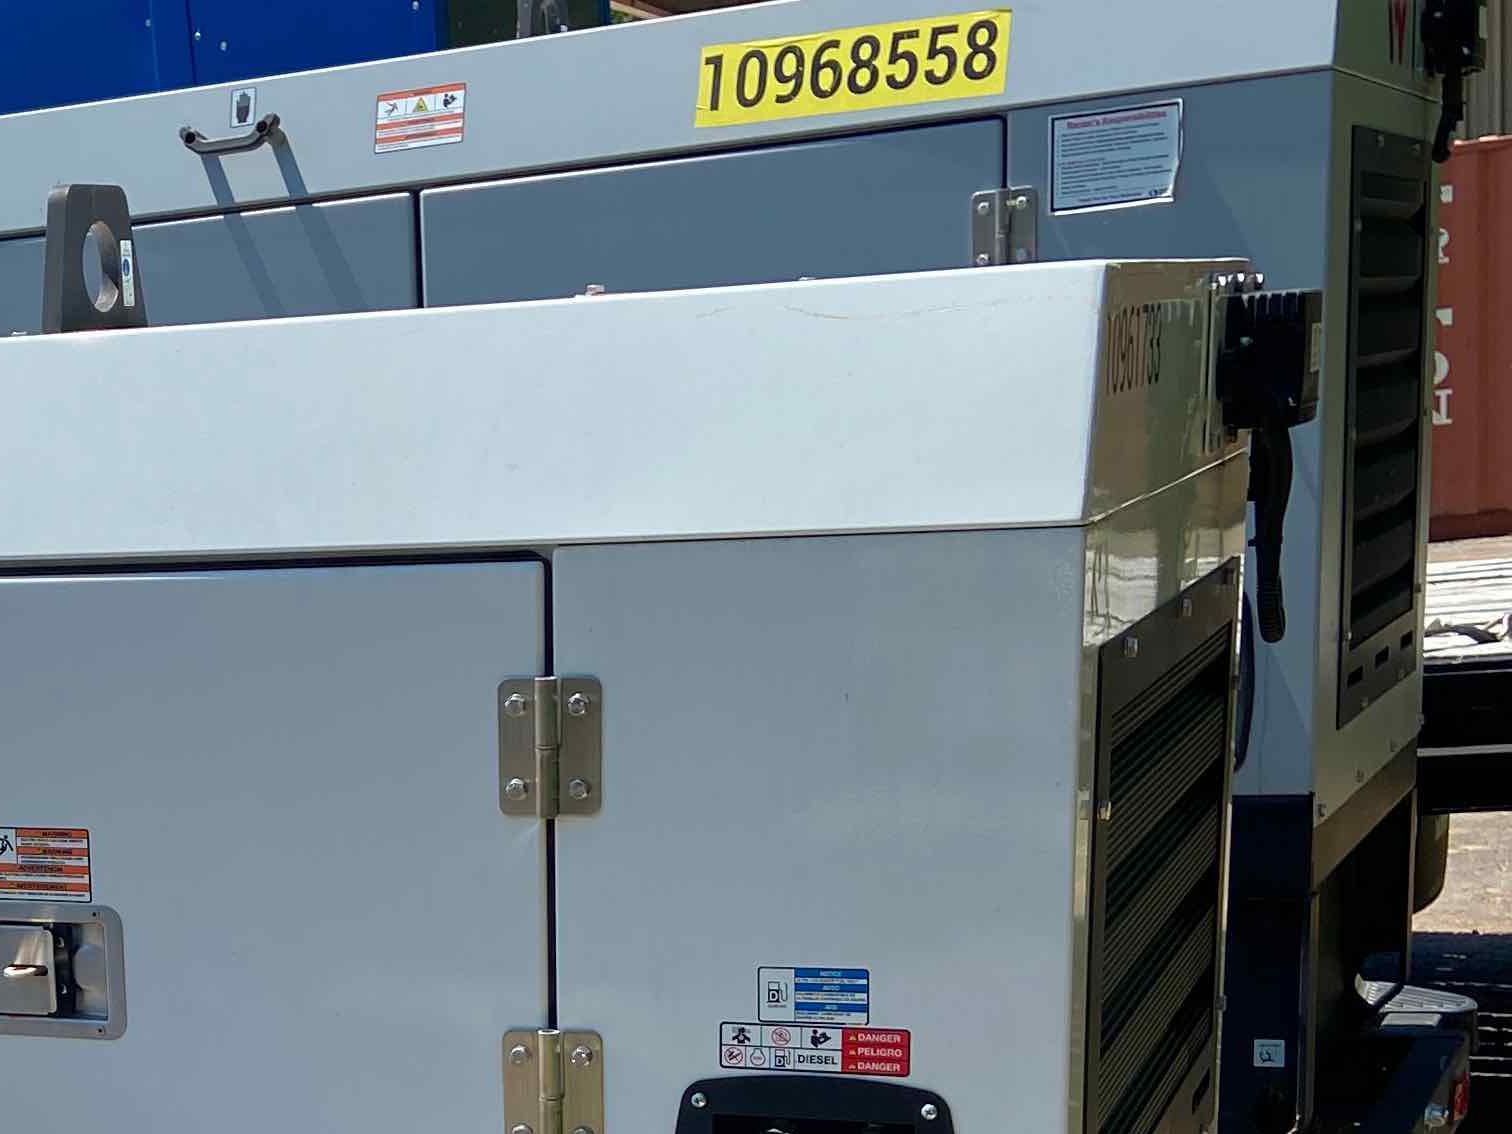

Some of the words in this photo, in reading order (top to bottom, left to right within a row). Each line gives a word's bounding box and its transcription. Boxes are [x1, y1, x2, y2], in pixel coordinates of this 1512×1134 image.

[704, 20, 998, 111] 10968558
[857, 1033, 902, 1044] DANGER
[857, 1047, 903, 1058] PELIGRO
[797, 1054, 838, 1066] DIESEL
[857, 1062, 901, 1073] DANGER
